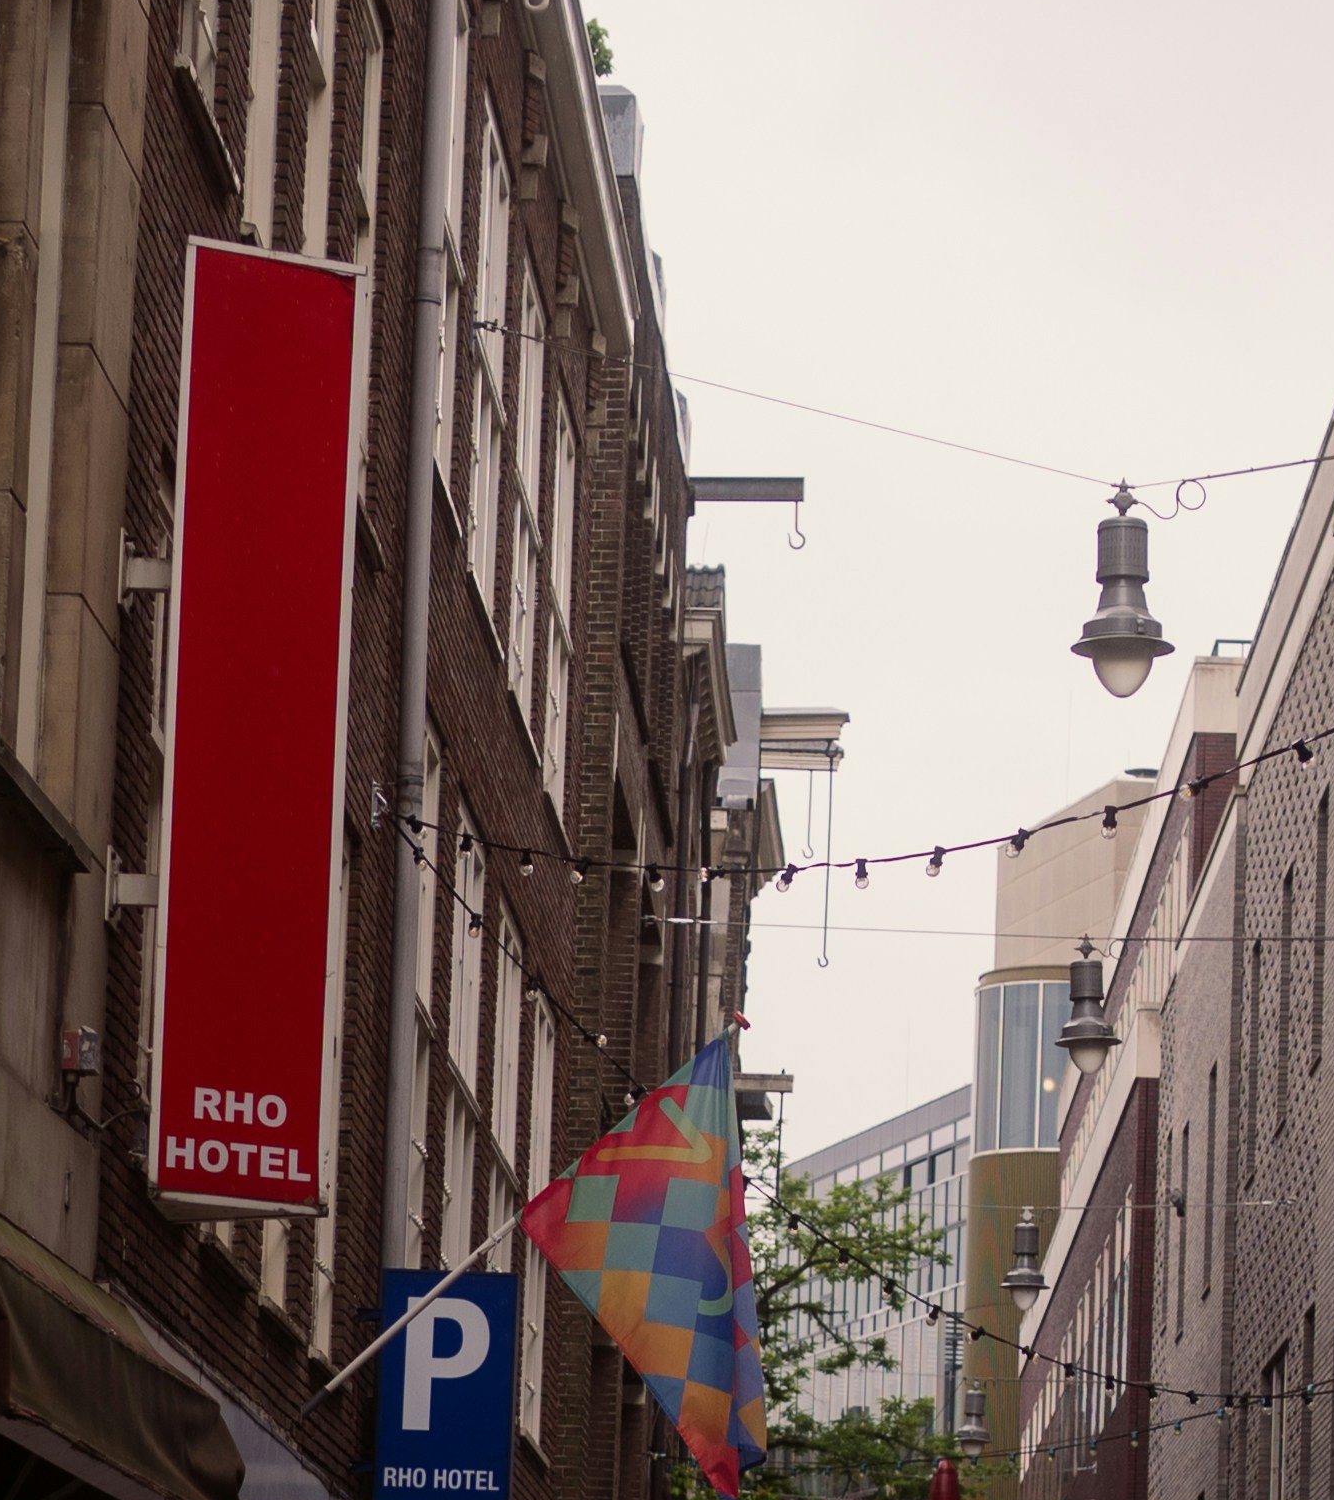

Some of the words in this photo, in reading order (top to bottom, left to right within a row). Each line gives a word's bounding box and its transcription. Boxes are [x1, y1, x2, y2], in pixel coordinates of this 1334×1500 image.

[193, 1086, 288, 1128] RHO
[165, 1135, 312, 1182] HOTEL
[401, 1296, 491, 1432] P
[382, 1466, 427, 1489] RHO
[433, 1468, 500, 1492] HOTEL
